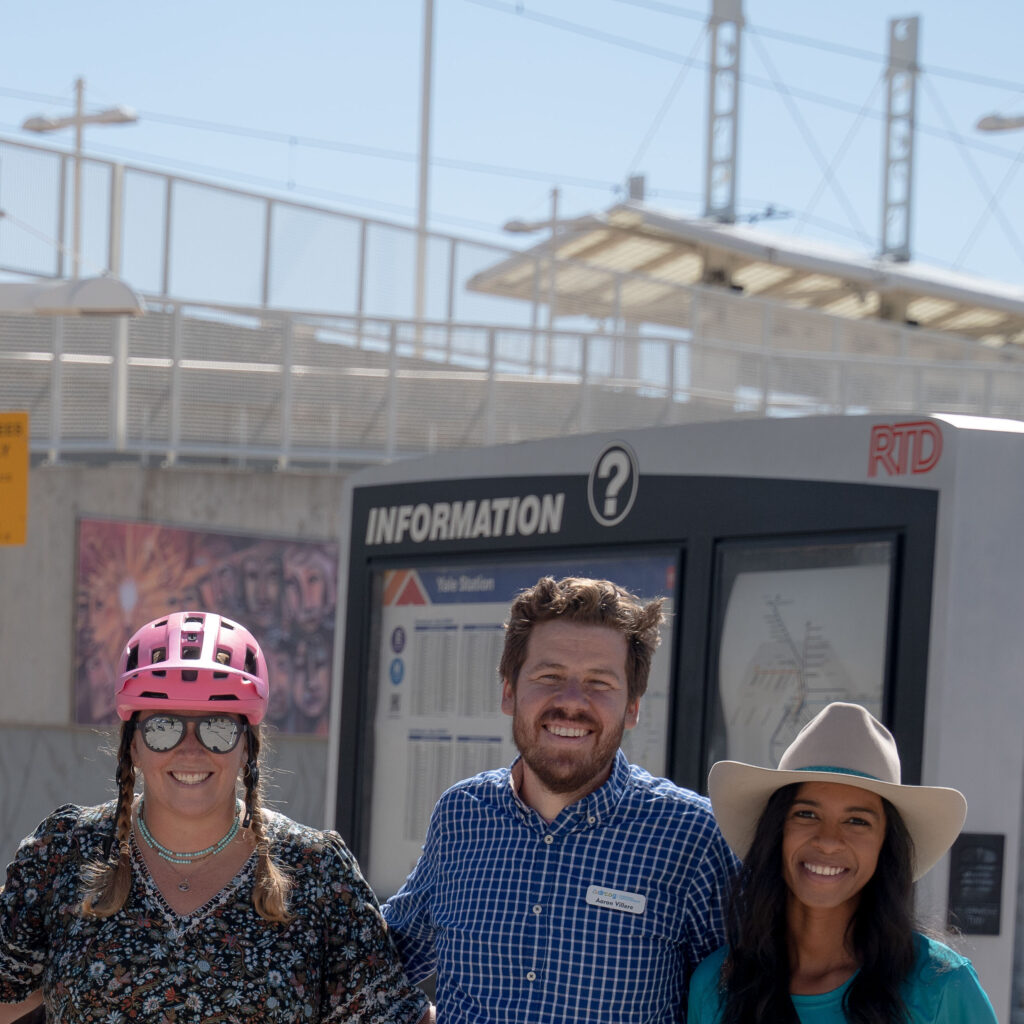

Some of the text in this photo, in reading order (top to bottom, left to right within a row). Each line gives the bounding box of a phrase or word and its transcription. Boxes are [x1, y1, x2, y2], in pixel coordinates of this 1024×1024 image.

[867, 420, 943, 478] RTD
[365, 493, 565, 545] INFORMATION
[459, 574, 495, 592] Station
